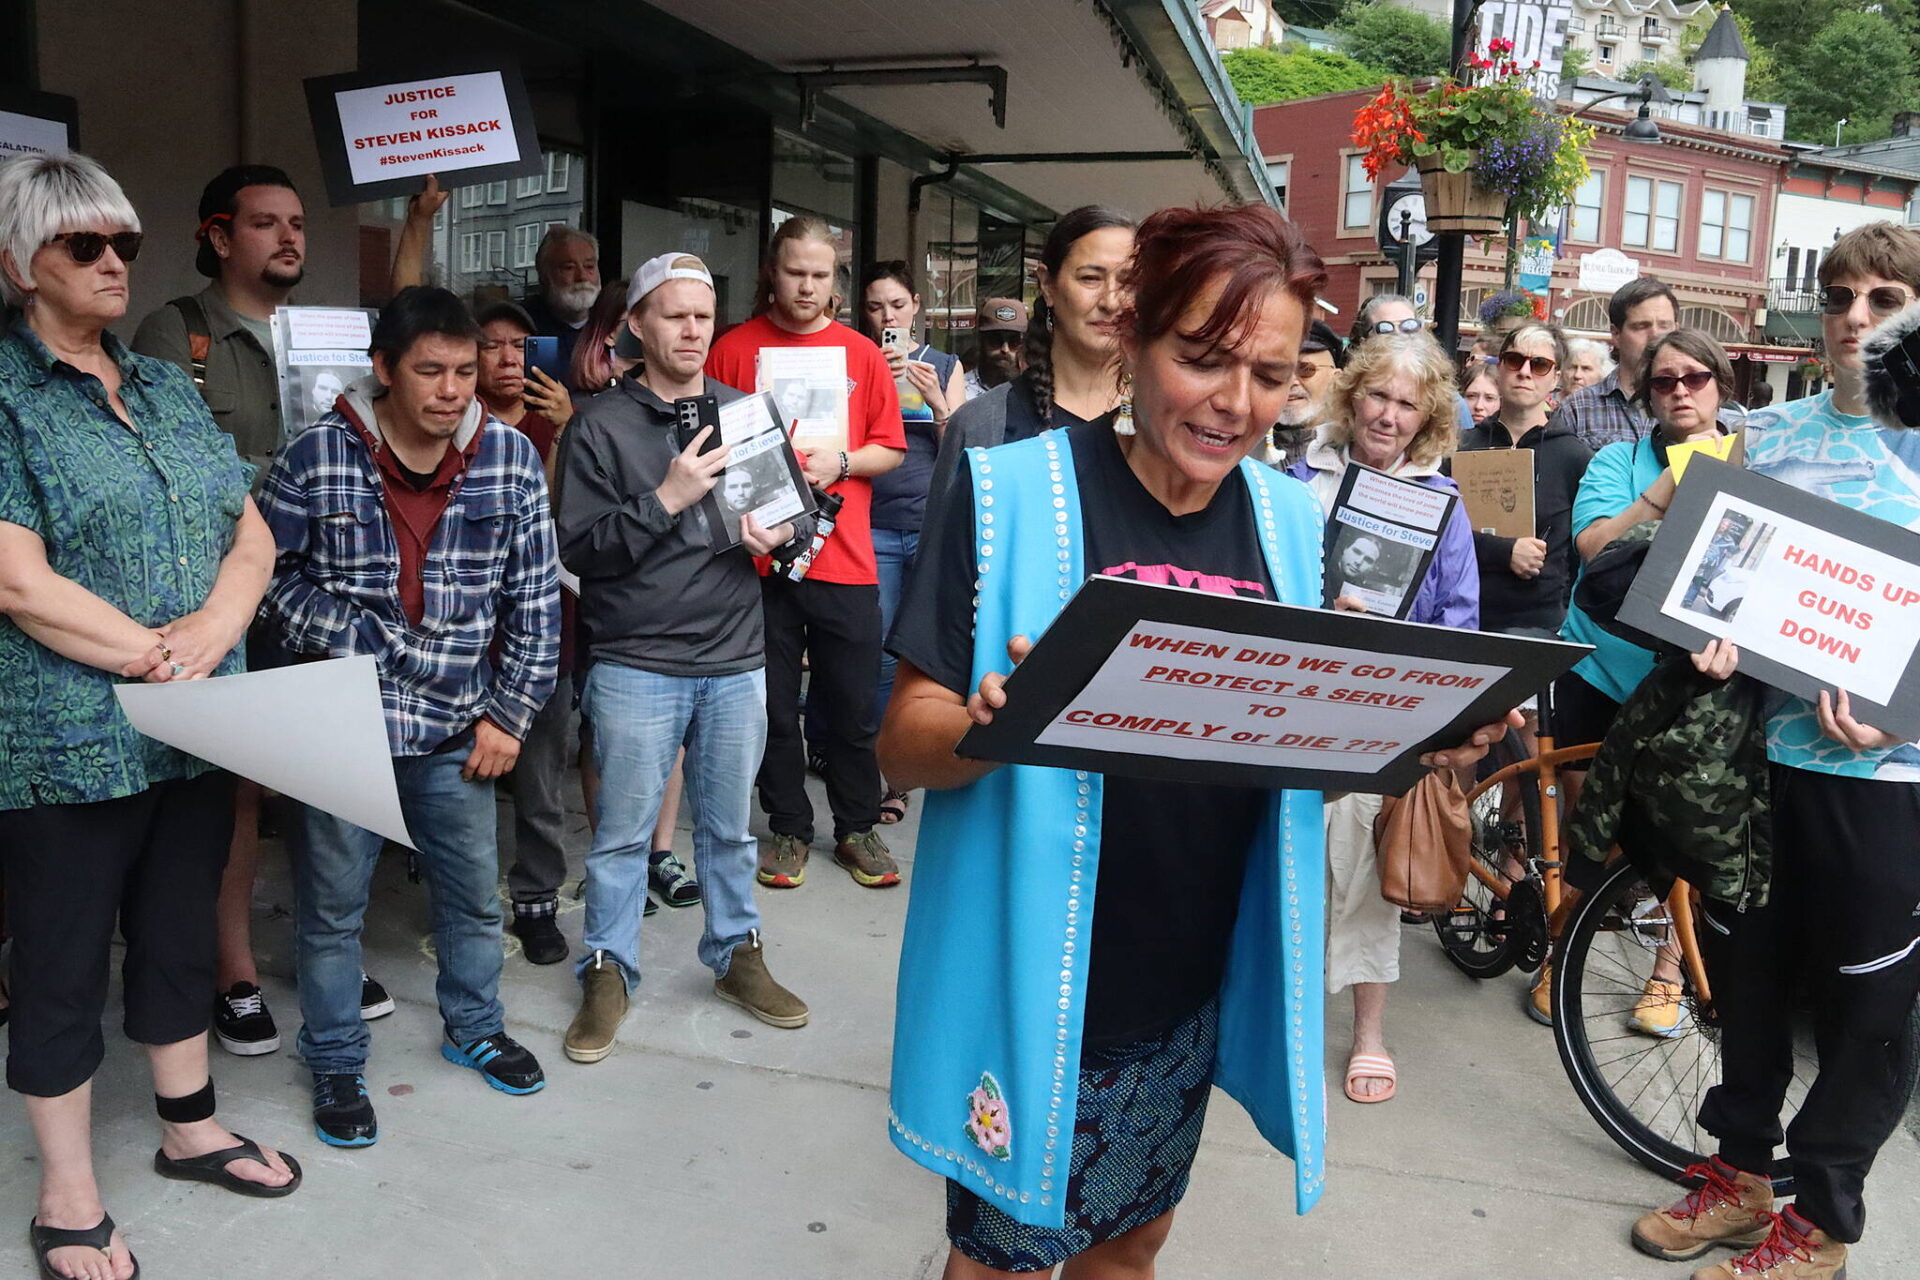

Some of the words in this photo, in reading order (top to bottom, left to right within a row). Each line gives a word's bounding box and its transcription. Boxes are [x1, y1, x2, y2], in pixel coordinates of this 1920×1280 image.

[1476, 2, 1571, 73] TIDE
[384, 86, 456, 105] JUSTICE
[410, 109, 438, 121] FOR
[354, 130, 422, 150] STEVEN
[427, 119, 501, 140] KISSACK
[379, 143, 486, 166] #StevenKissack
[291, 352, 328, 363] Justice
[332, 352, 346, 362] for
[349, 353, 370, 363] Stev
[1338, 509, 1379, 531] Justice
[1381, 524, 1399, 537] for
[1400, 530, 1433, 547] Steve
[1783, 545, 1875, 592] HANDS
[1882, 582, 1920, 608] UP
[1798, 589, 1874, 631] GUNS
[1129, 632, 1230, 660] WHEN
[1233, 648, 1291, 667] DID
[1298, 656, 1348, 675] WE
[1351, 664, 1397, 680] GO
[1399, 670, 1484, 690] FROM
[1779, 619, 1861, 664] DOWN
[1144, 666, 1294, 695] PROTECT
[1298, 684, 1318, 698] &
[1328, 688, 1425, 710] SERVE
[1065, 710, 1228, 737] COMPLY
[1231, 731, 1269, 744] or
[1275, 732, 1338, 750] DIE
[1344, 738, 1401, 753] ???
[1247, 704, 1287, 719] TO
